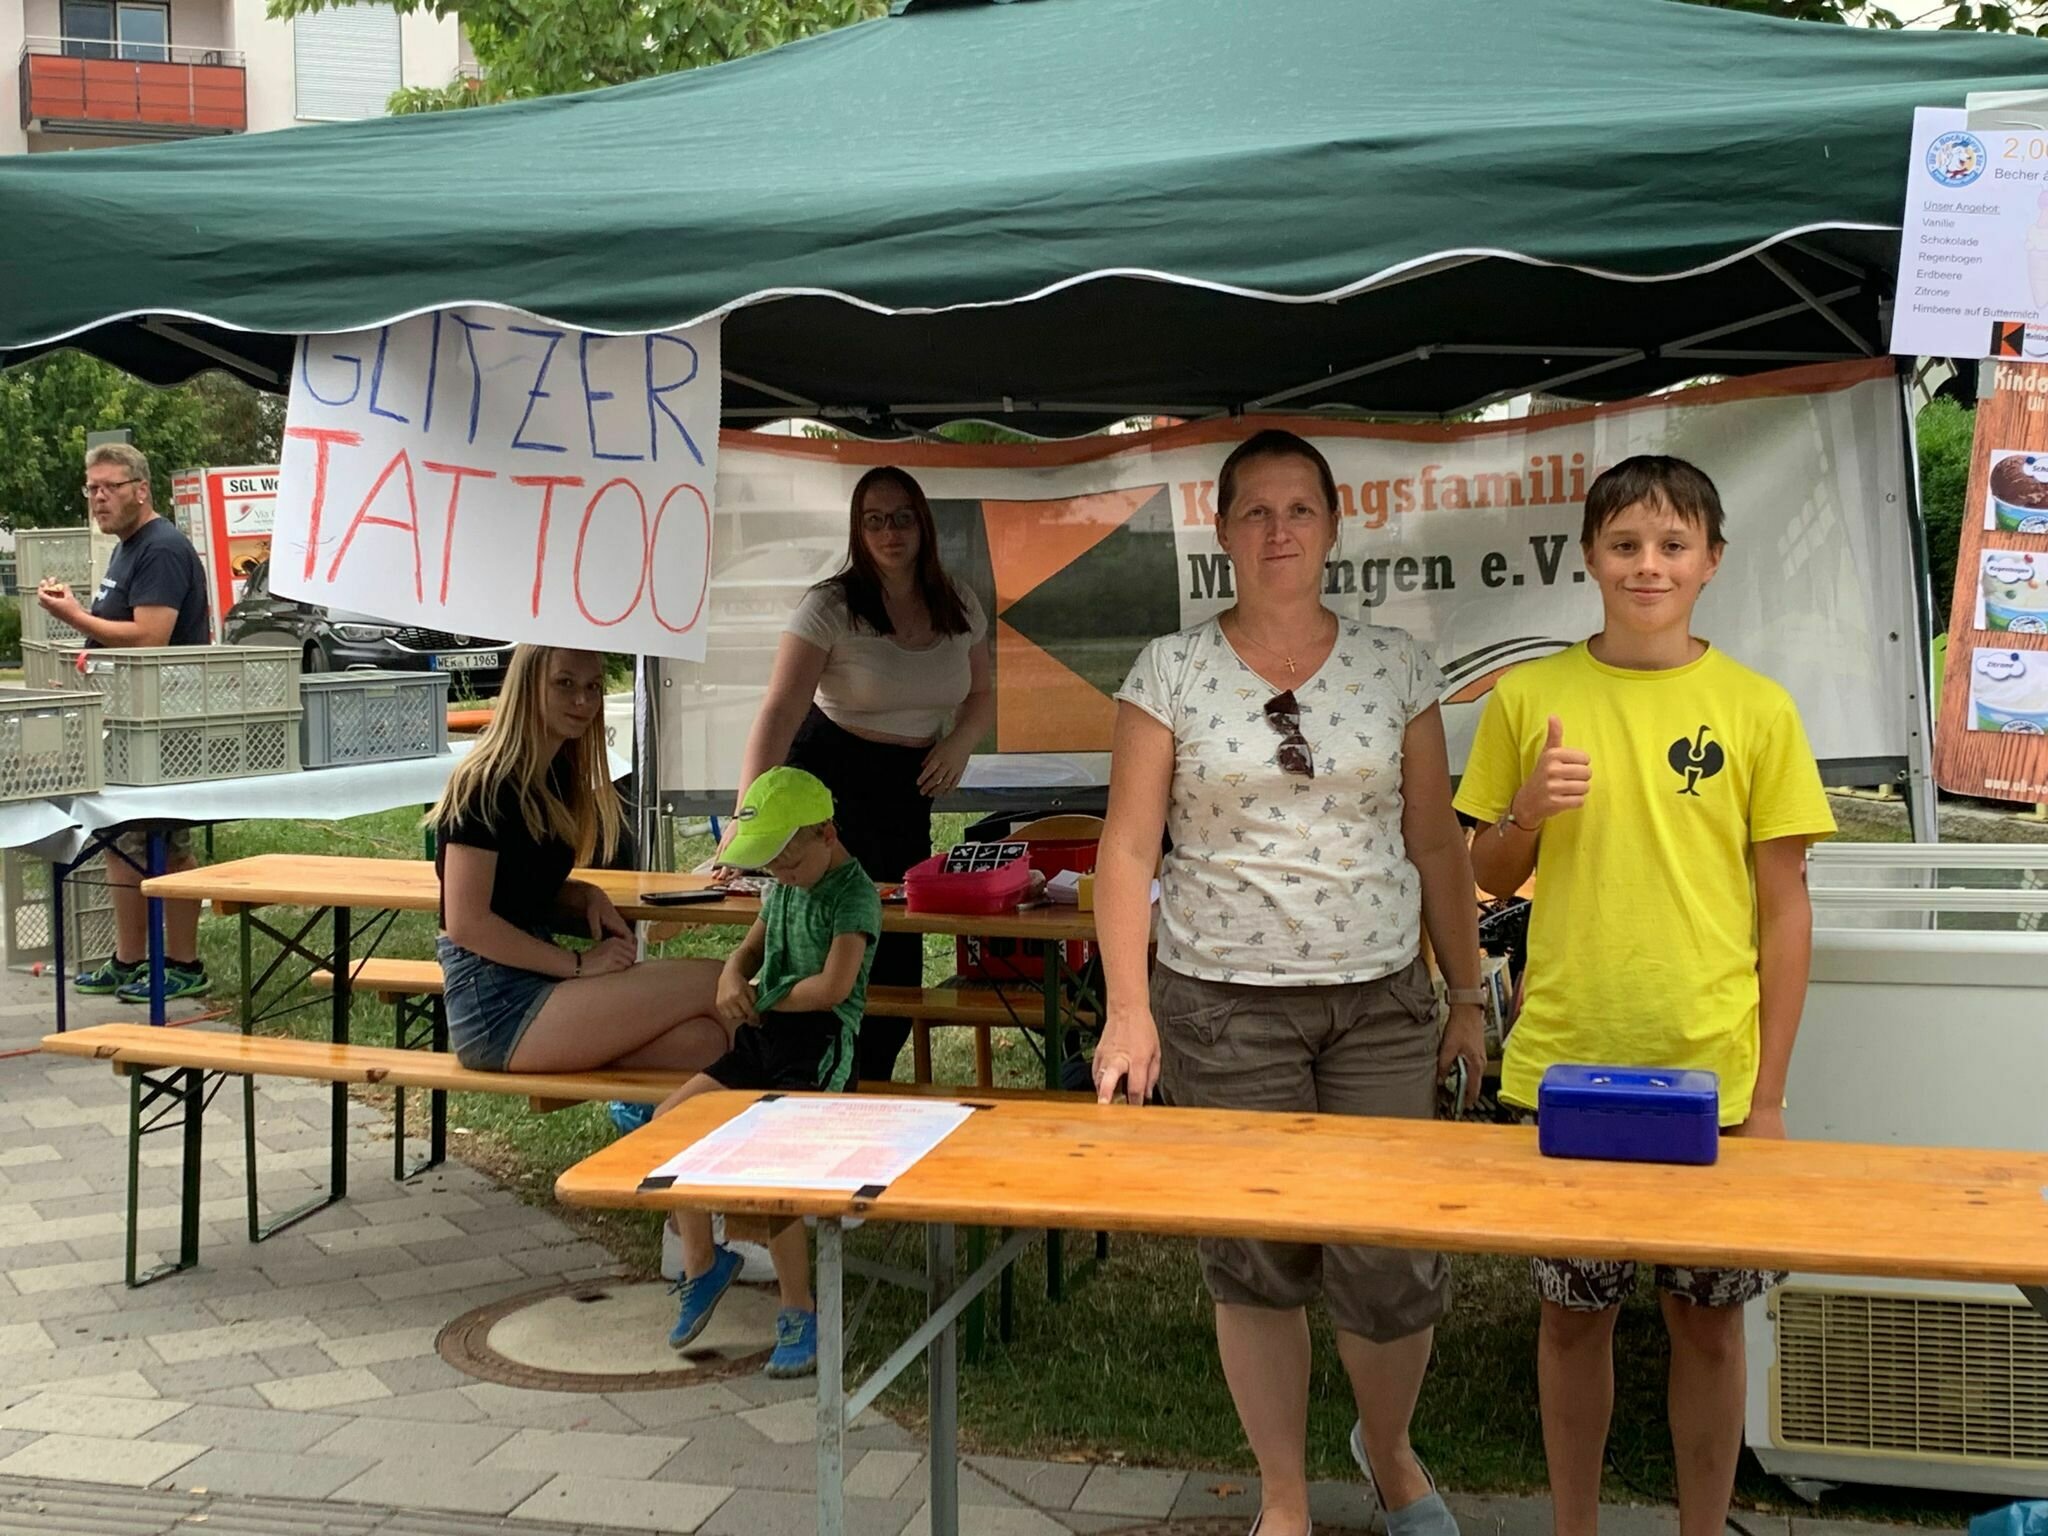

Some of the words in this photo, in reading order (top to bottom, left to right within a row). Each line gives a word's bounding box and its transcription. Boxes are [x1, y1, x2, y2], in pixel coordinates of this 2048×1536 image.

[2003, 138, 2048, 162] 2,0
[1995, 168, 2039, 181] Becher
[1923, 200, 1954, 211] Unser
[1922, 218, 1955, 228] Vanille
[1920, 234, 1979, 246] Schokolade
[1918, 252, 1983, 265] Regenbogen
[1916, 269, 1963, 280] Erdbeere
[1914, 286, 1950, 297] Zitrone
[1912, 303, 1961, 315] Himbeere
[1964, 306, 1981, 317] auf
[1982, 307, 2040, 320] Buttermilch
[302, 311, 706, 466] GLITZER
[229, 479, 258, 493] SGL
[285, 426, 711, 633] TATTOO
[1187, 553, 1456, 607] Mngen
[1480, 534, 1586, 587] e.V.
[436, 656, 457, 668] WER
[473, 654, 497, 667] 1965
